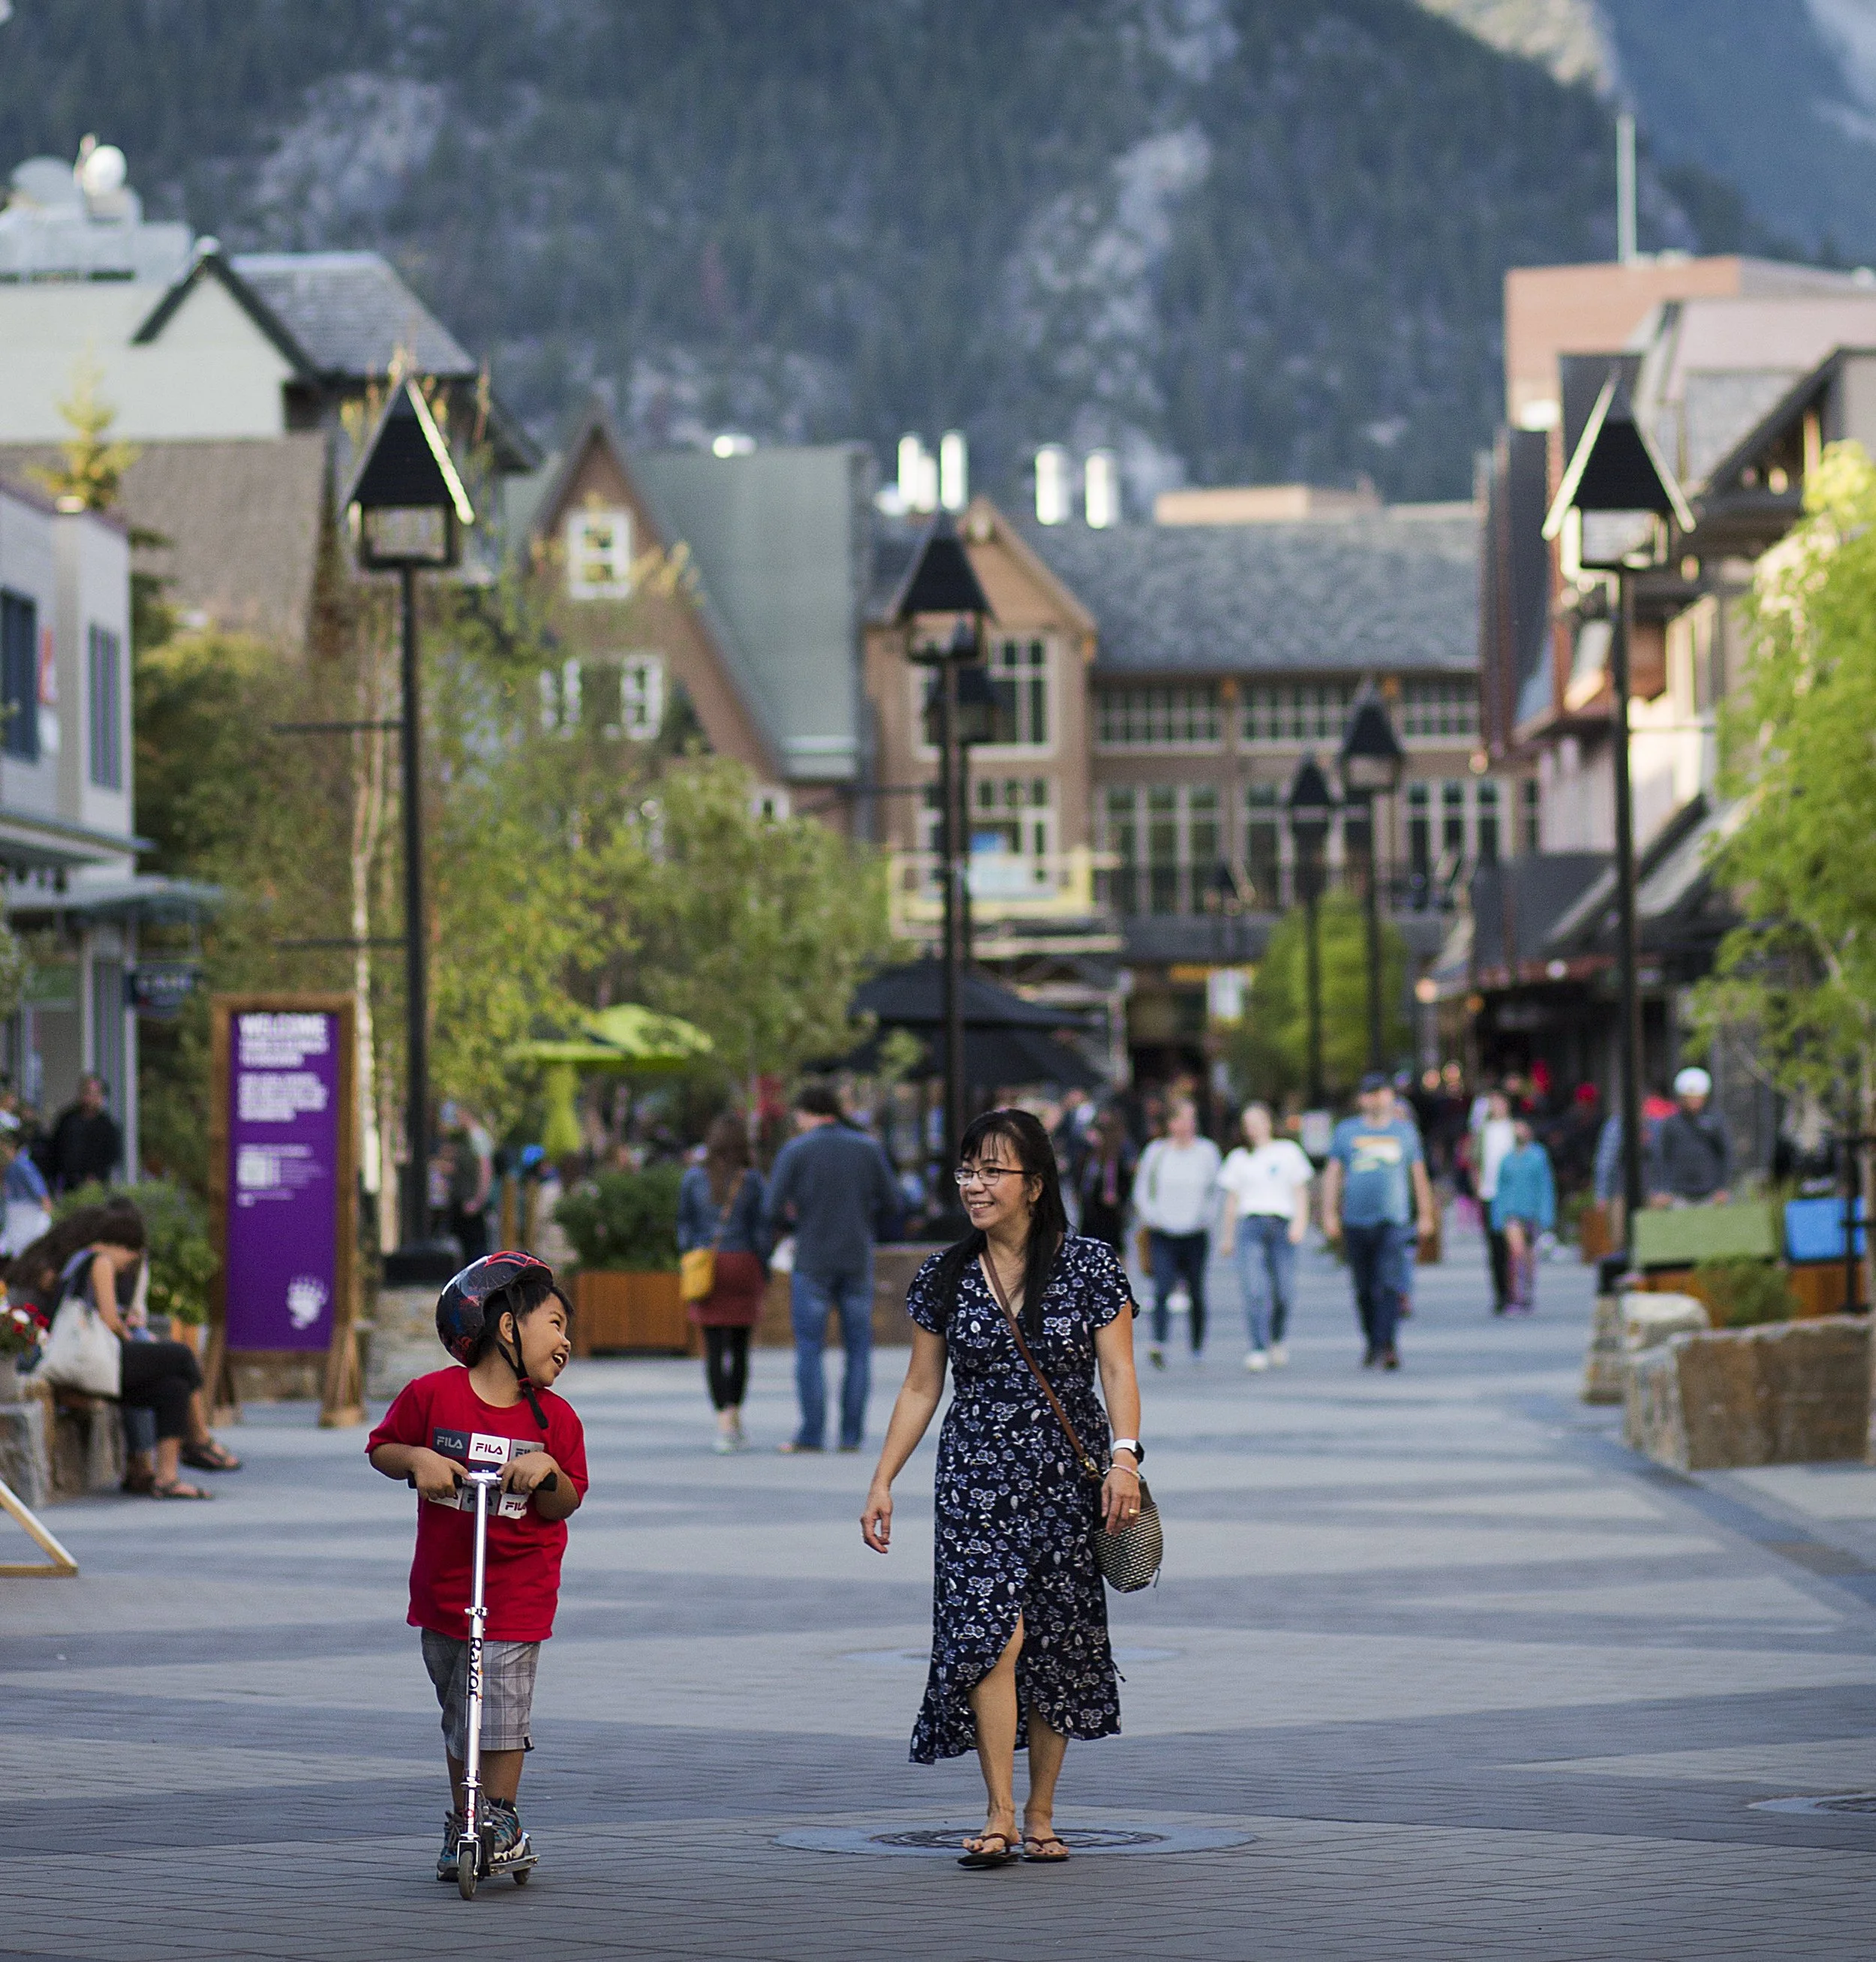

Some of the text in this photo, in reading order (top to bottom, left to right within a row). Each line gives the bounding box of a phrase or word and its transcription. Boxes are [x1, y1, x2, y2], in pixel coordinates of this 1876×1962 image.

[437, 1436, 463, 1449] FILA
[475, 1443, 503, 1455] FILA
[468, 1637, 483, 1702] Razor
